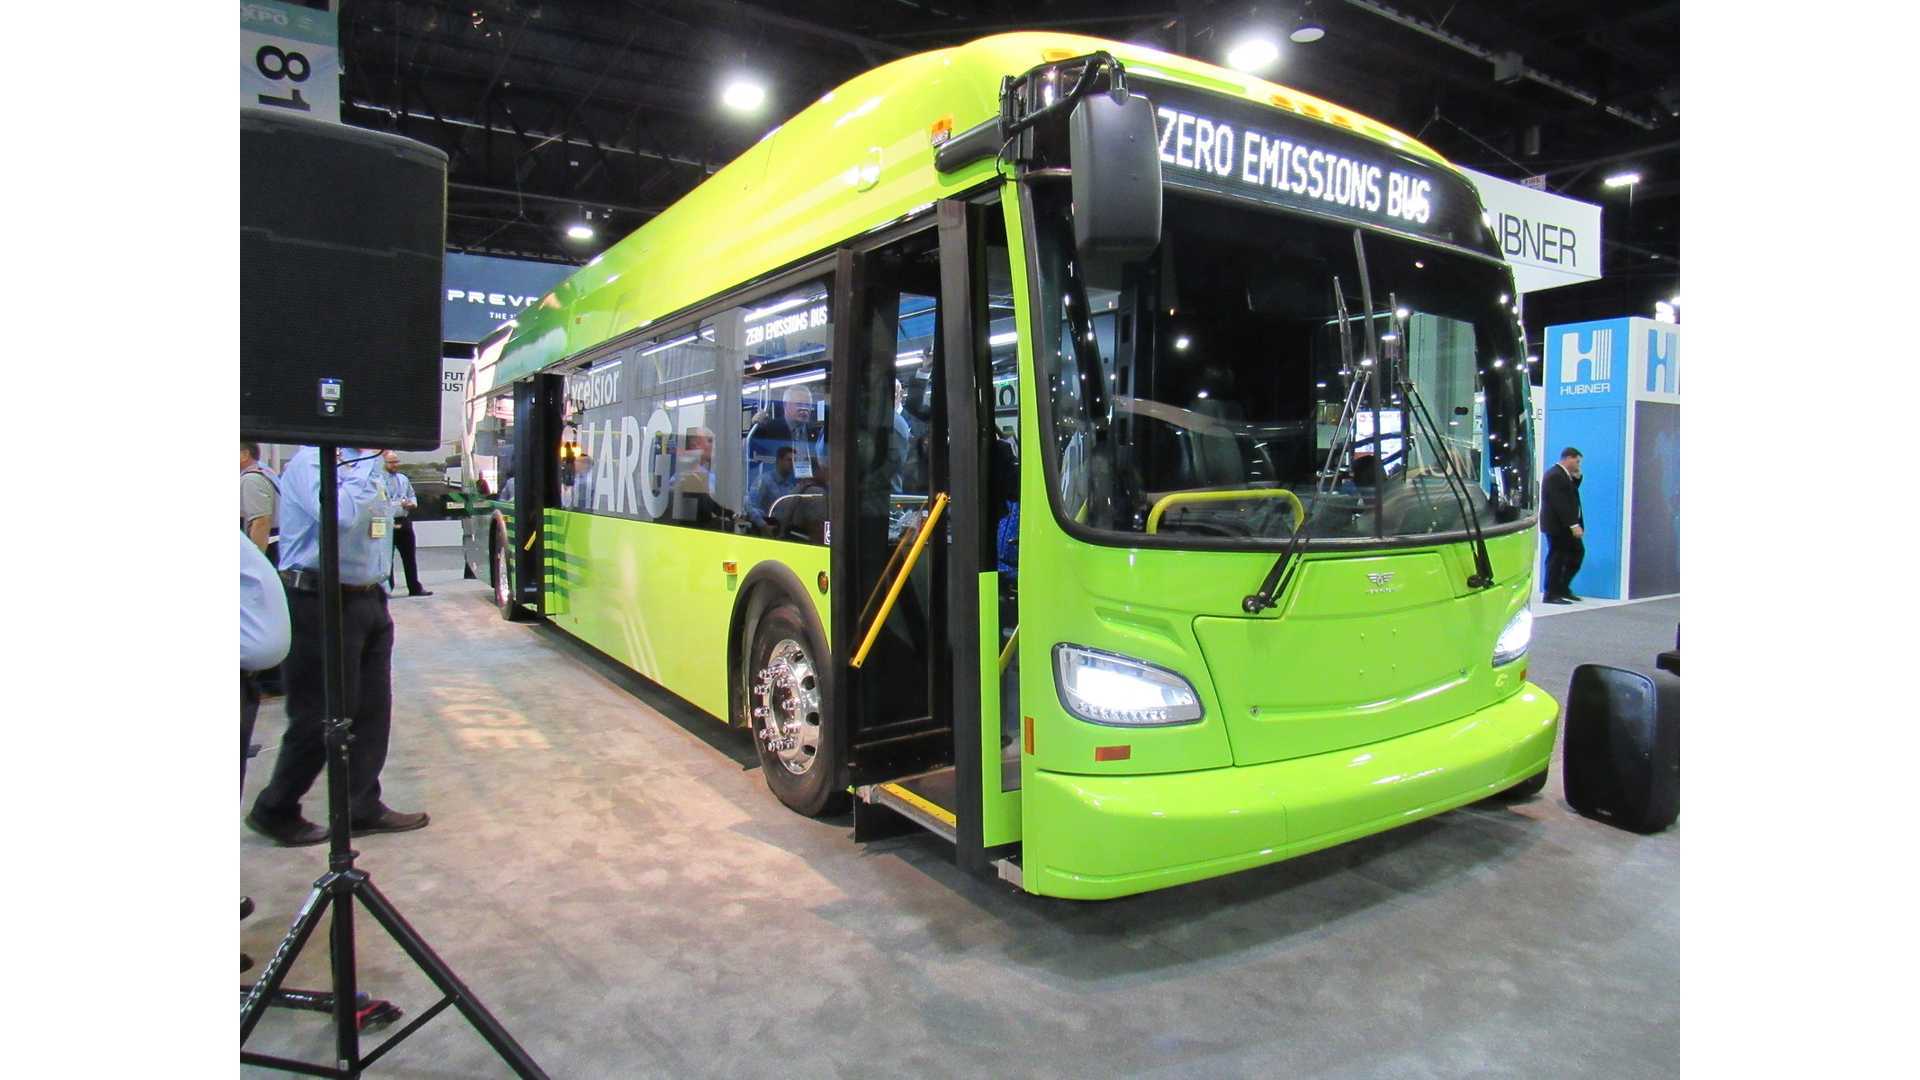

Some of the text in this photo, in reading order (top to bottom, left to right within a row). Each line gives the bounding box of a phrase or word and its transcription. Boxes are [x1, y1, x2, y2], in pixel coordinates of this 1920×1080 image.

[1157, 106, 1433, 225] ZERO EMISSIONS BUS
[1498, 211, 1577, 267] BNER
[489, 311, 507, 320] THE
